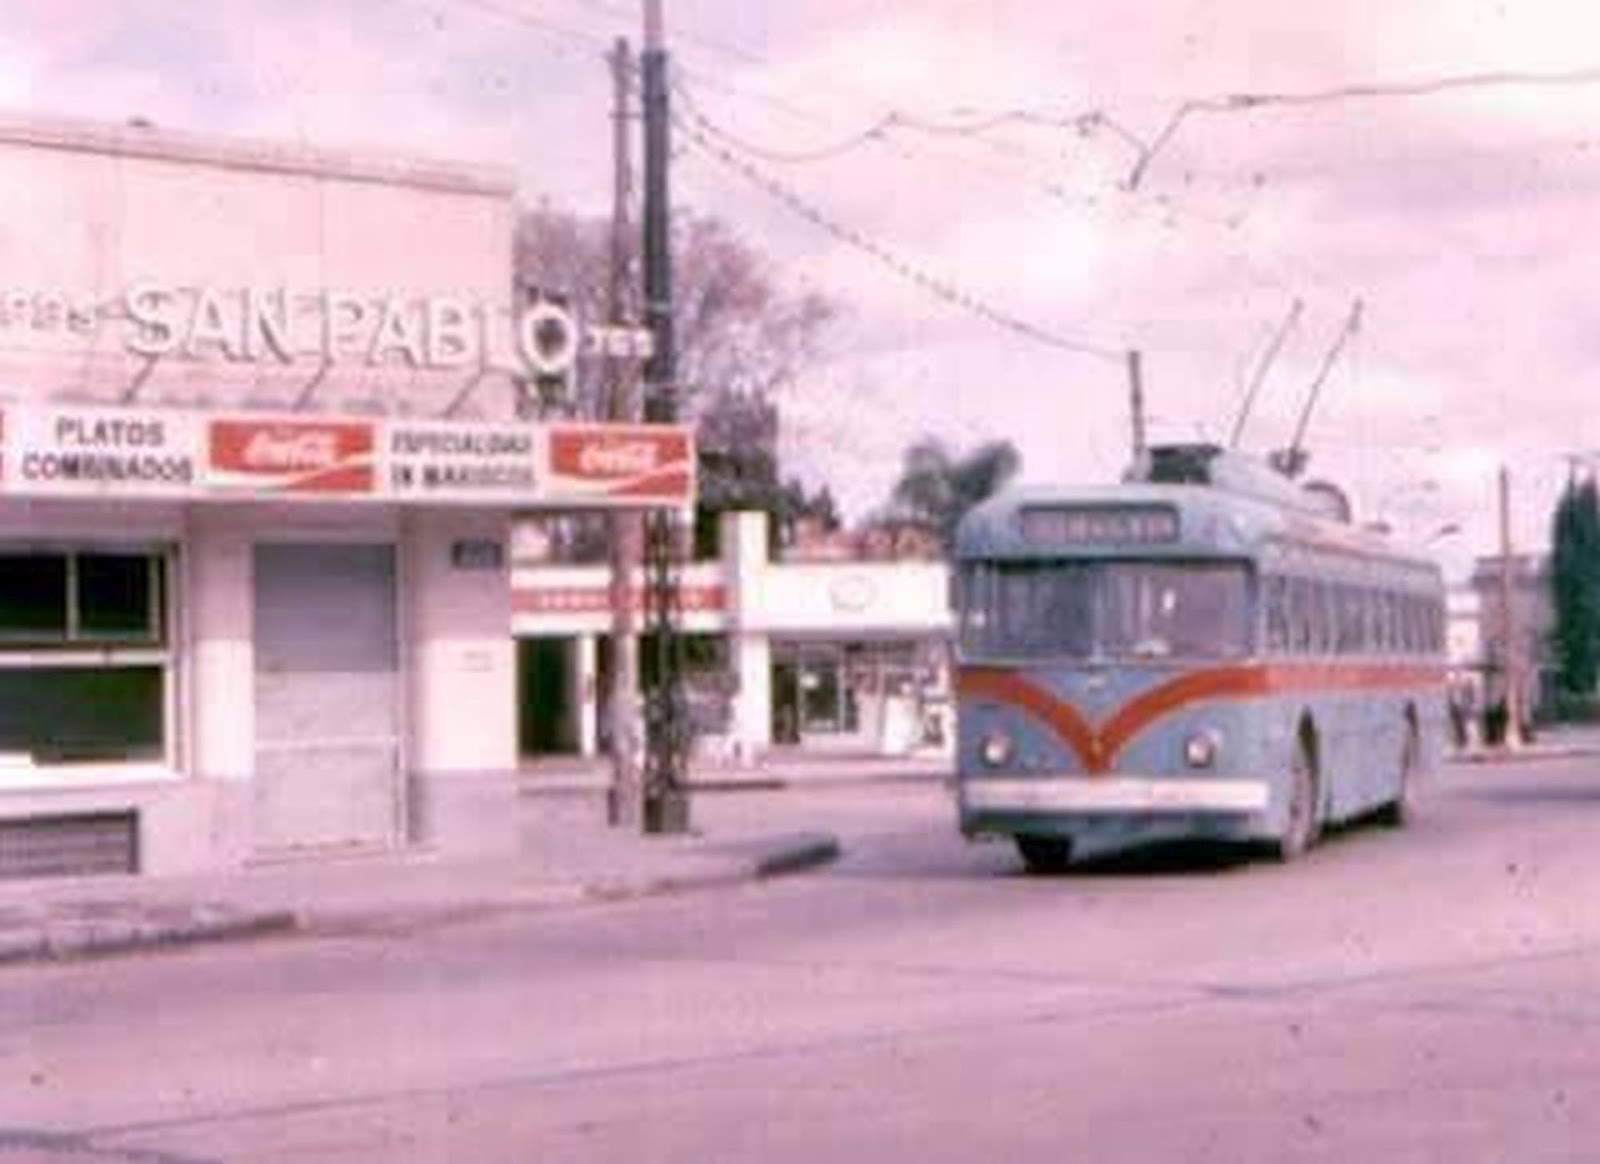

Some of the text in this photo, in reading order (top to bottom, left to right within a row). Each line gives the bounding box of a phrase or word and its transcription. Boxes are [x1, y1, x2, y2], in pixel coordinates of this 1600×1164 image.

[124, 280, 291, 363] SAN
[323, 292, 578, 374] PABLO
[55, 416, 165, 447] PLATOS
[21, 452, 194, 482] COMBINADOS
